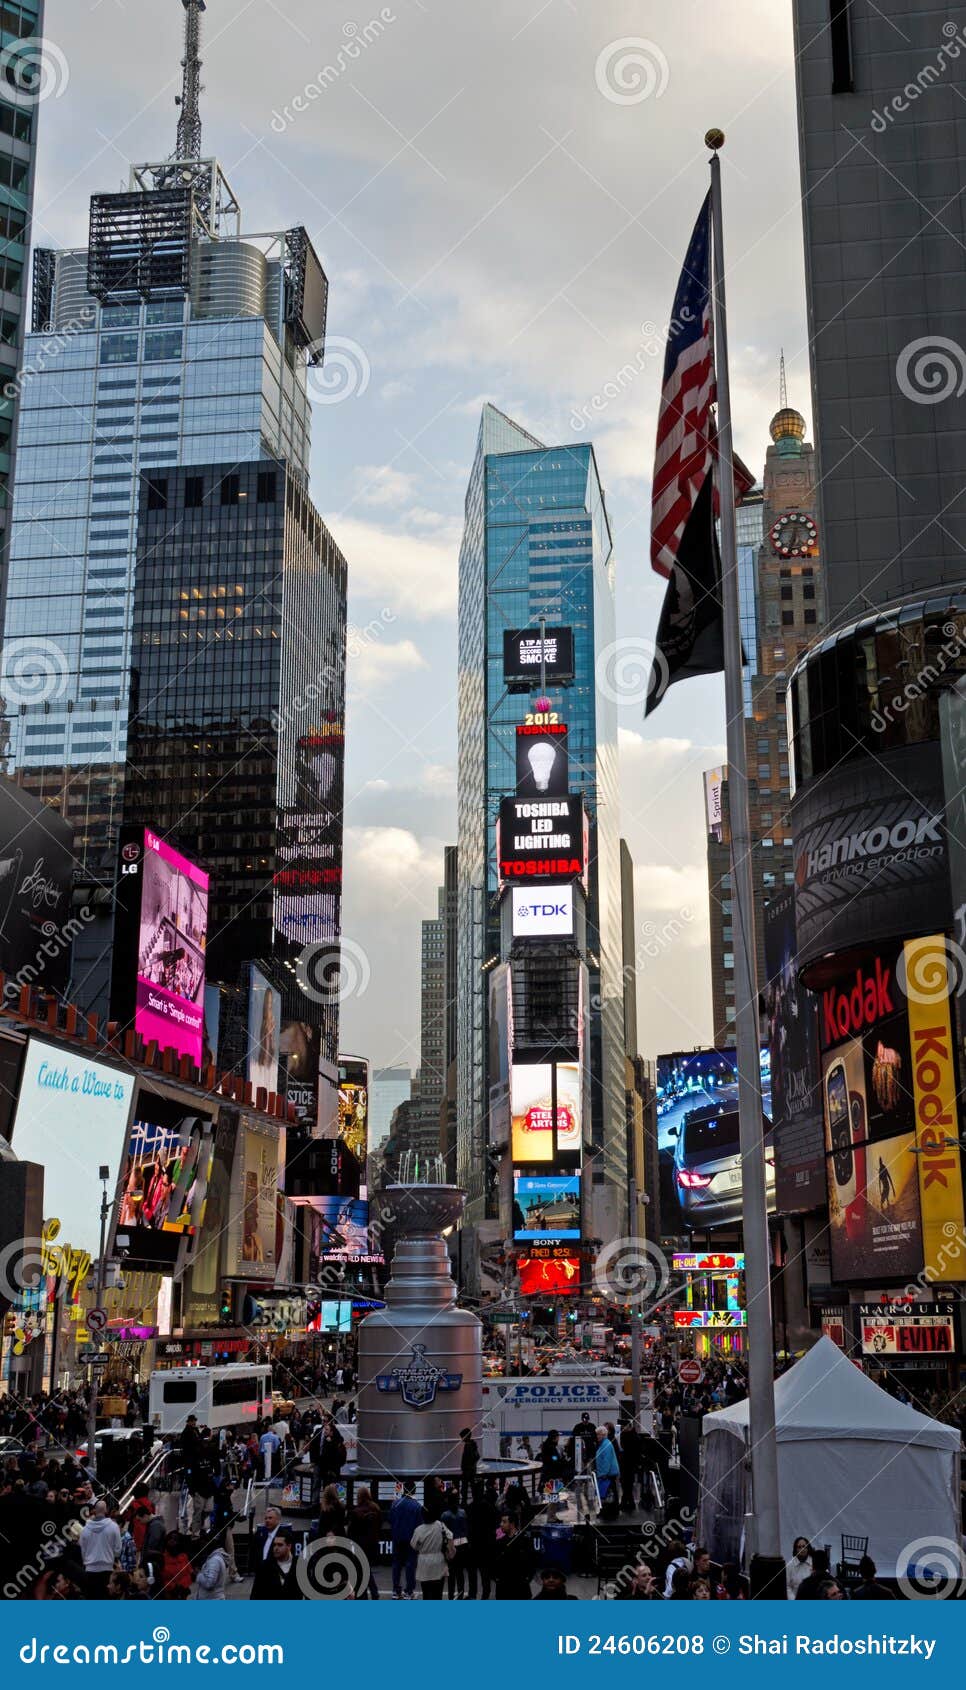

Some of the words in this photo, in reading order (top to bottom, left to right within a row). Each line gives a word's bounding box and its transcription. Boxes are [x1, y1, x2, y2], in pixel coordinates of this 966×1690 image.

[520, 653, 557, 664] SMOKE
[525, 713, 558, 725] 2012
[517, 726, 567, 736] TOSHIBA
[515, 802, 569, 818] TOSHIBA
[711, 786, 721, 818] Sprint
[531, 819, 553, 833] LED
[514, 834, 571, 850] LIGHTING
[122, 864, 138, 874] LG
[501, 859, 582, 875] TOSHIBA
[822, 861, 864, 883] driving
[867, 846, 944, 869] emotion
[529, 904, 567, 916] TDK
[148, 992, 163, 1011] Smart
[162, 1002, 168, 1013] is
[823, 957, 894, 1045] Kodak
[37, 1060, 69, 1091] Catch
[71, 1075, 79, 1093] a
[82, 1069, 111, 1098] Wave
[113, 1081, 124, 1100] to
[914, 1026, 957, 1190] Kodak
[330, 1139, 338, 1175] 1500
[860, 1303, 953, 1314] MARQUIS
[899, 1326, 949, 1352] EVITA
[515, 1385, 601, 1397] POLICE
